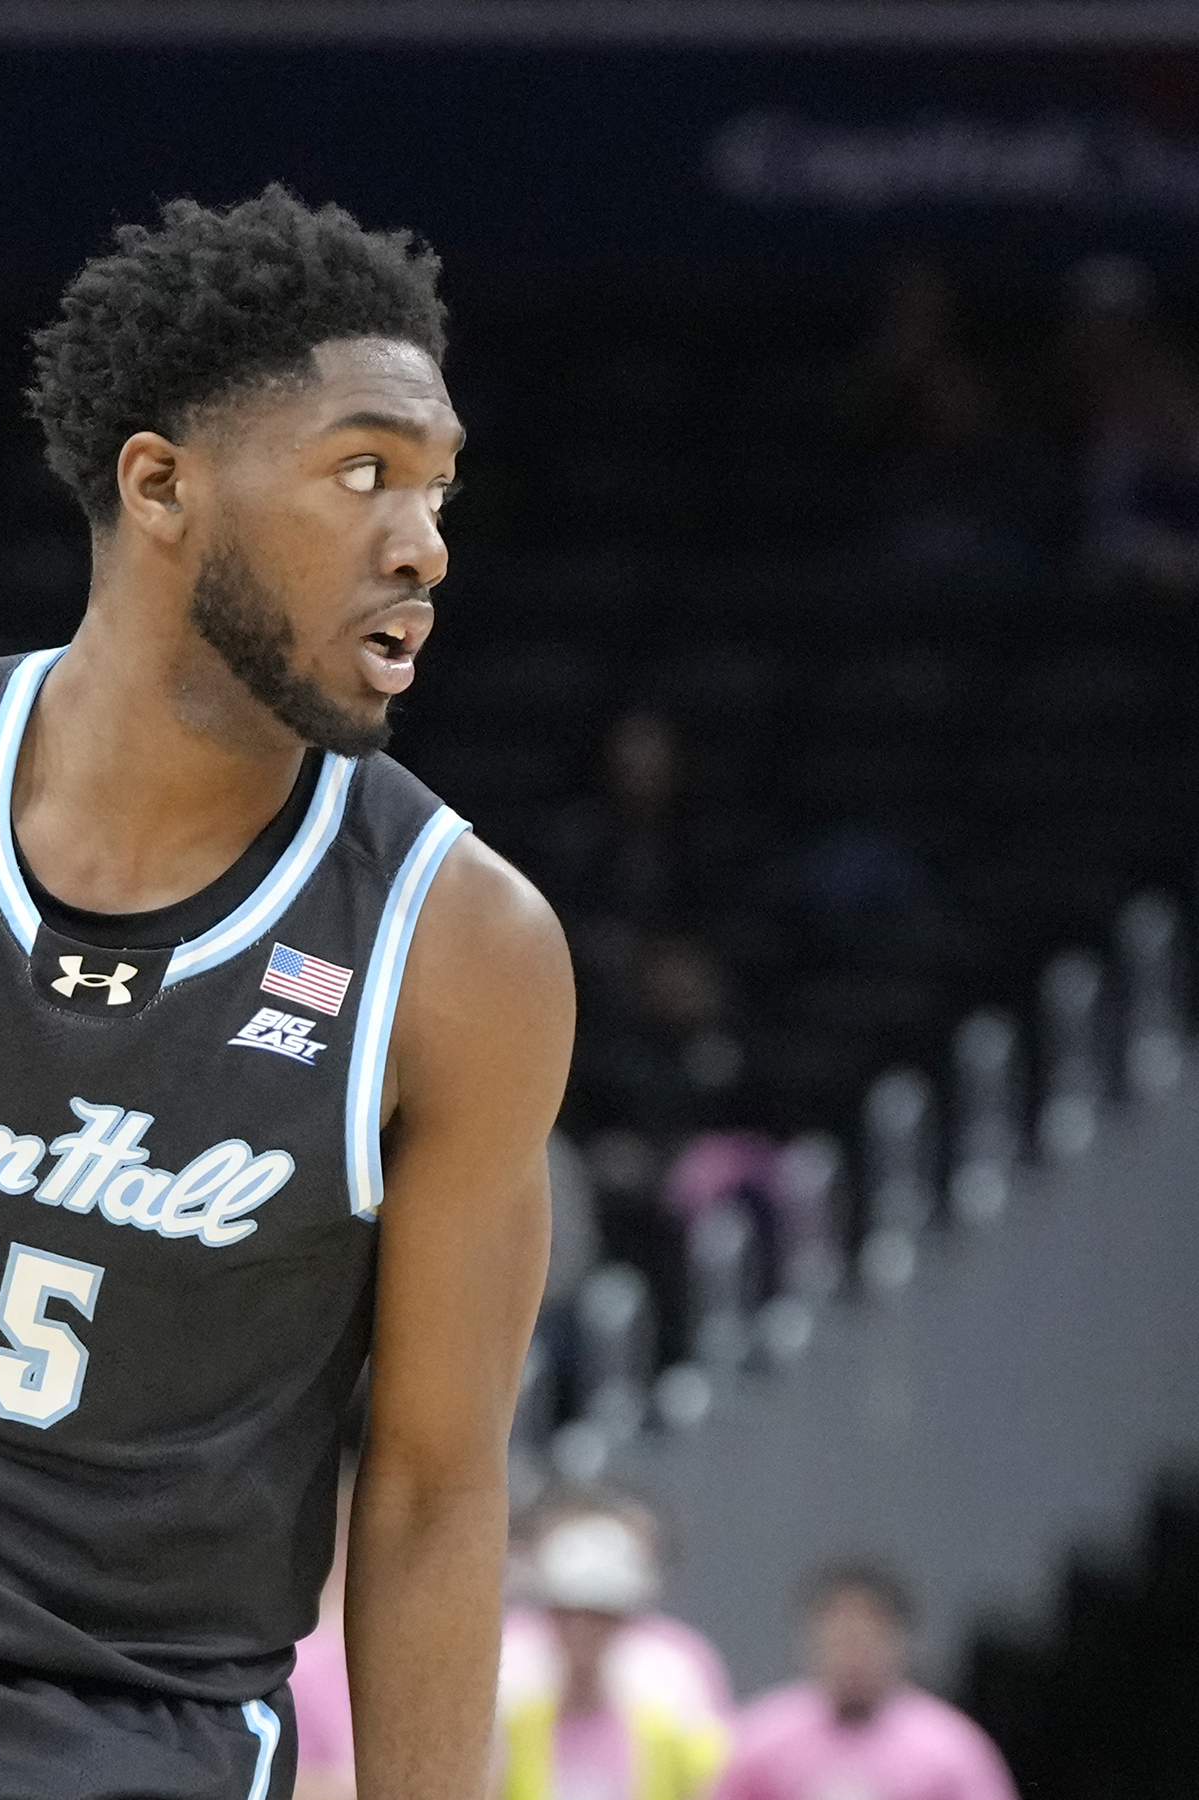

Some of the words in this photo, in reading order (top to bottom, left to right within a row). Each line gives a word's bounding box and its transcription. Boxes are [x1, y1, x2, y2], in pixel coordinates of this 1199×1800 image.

[236, 1021, 328, 1059] EAST
[250, 1006, 317, 1037] BIG
[33, 1096, 296, 1248] Hall
